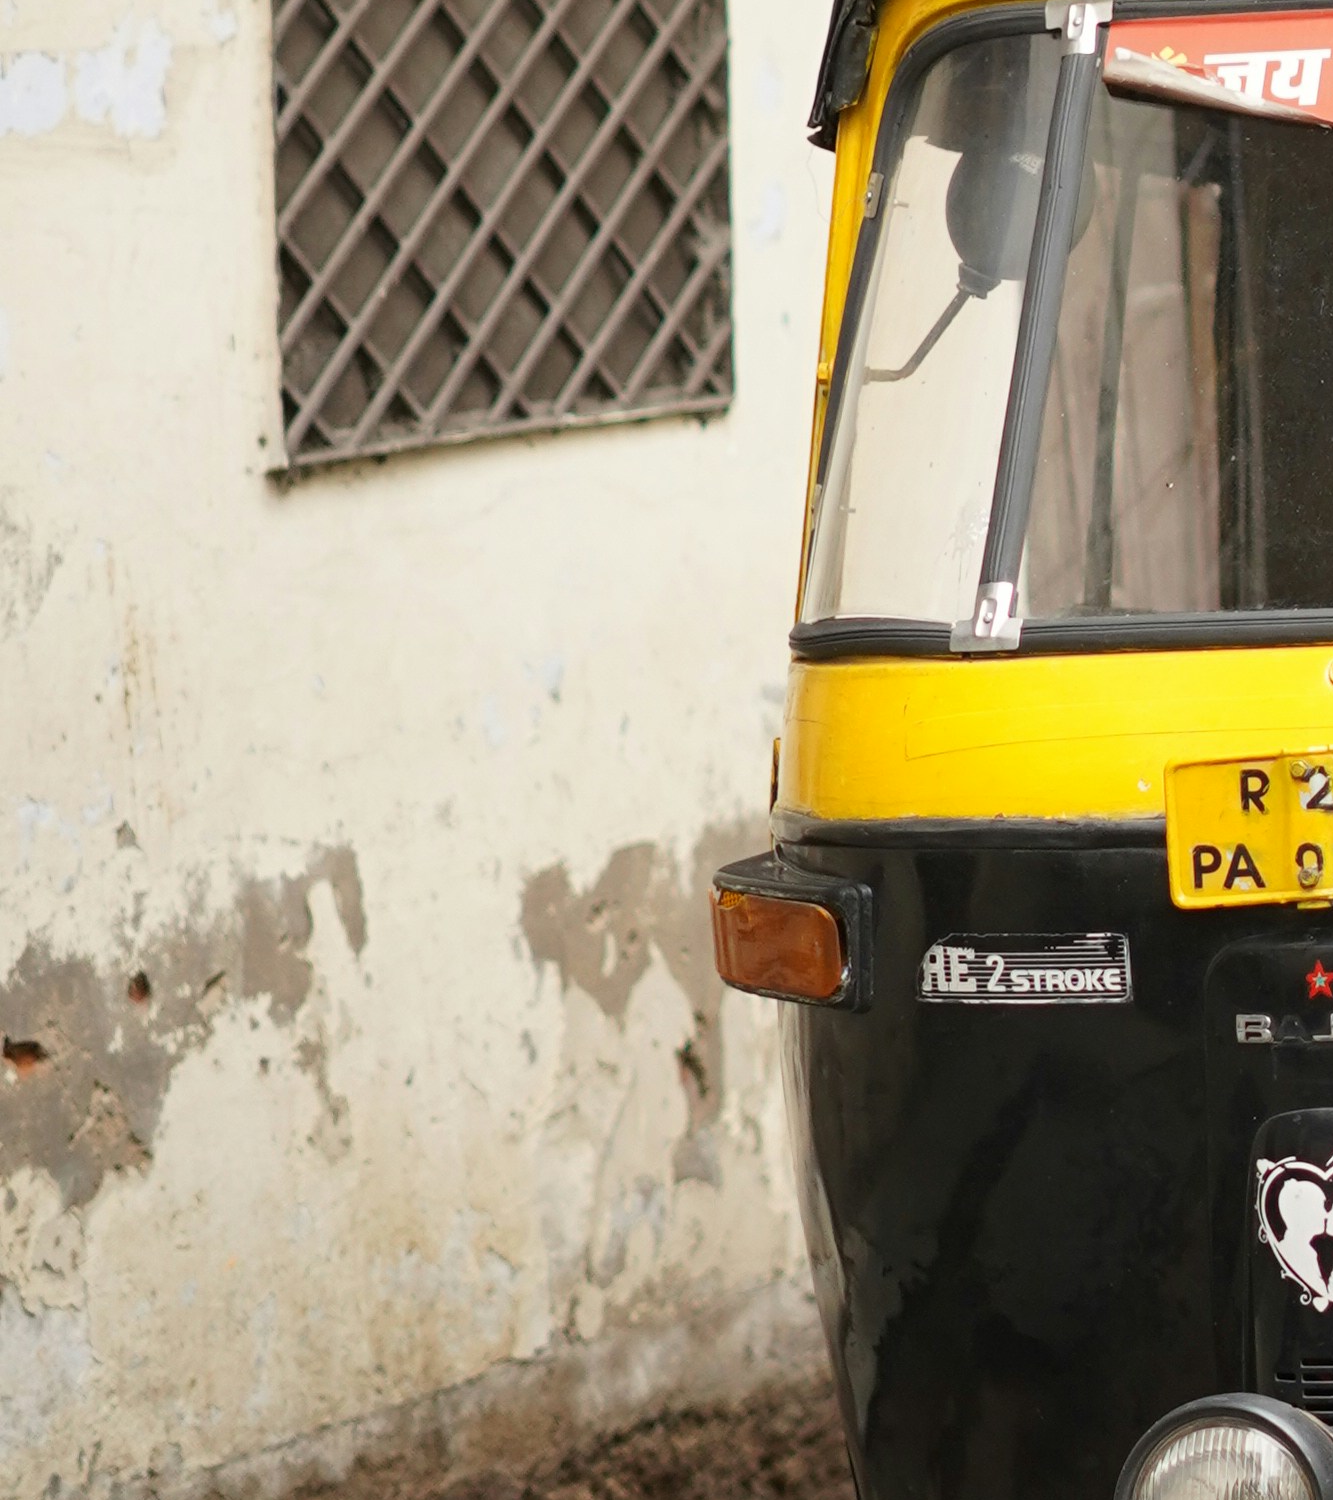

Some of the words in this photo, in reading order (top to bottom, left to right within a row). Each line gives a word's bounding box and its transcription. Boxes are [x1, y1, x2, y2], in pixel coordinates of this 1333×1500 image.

[1191, 842, 1267, 891] PA
[985, 954, 1008, 994] 2
[1010, 967, 1123, 994] STROKE
